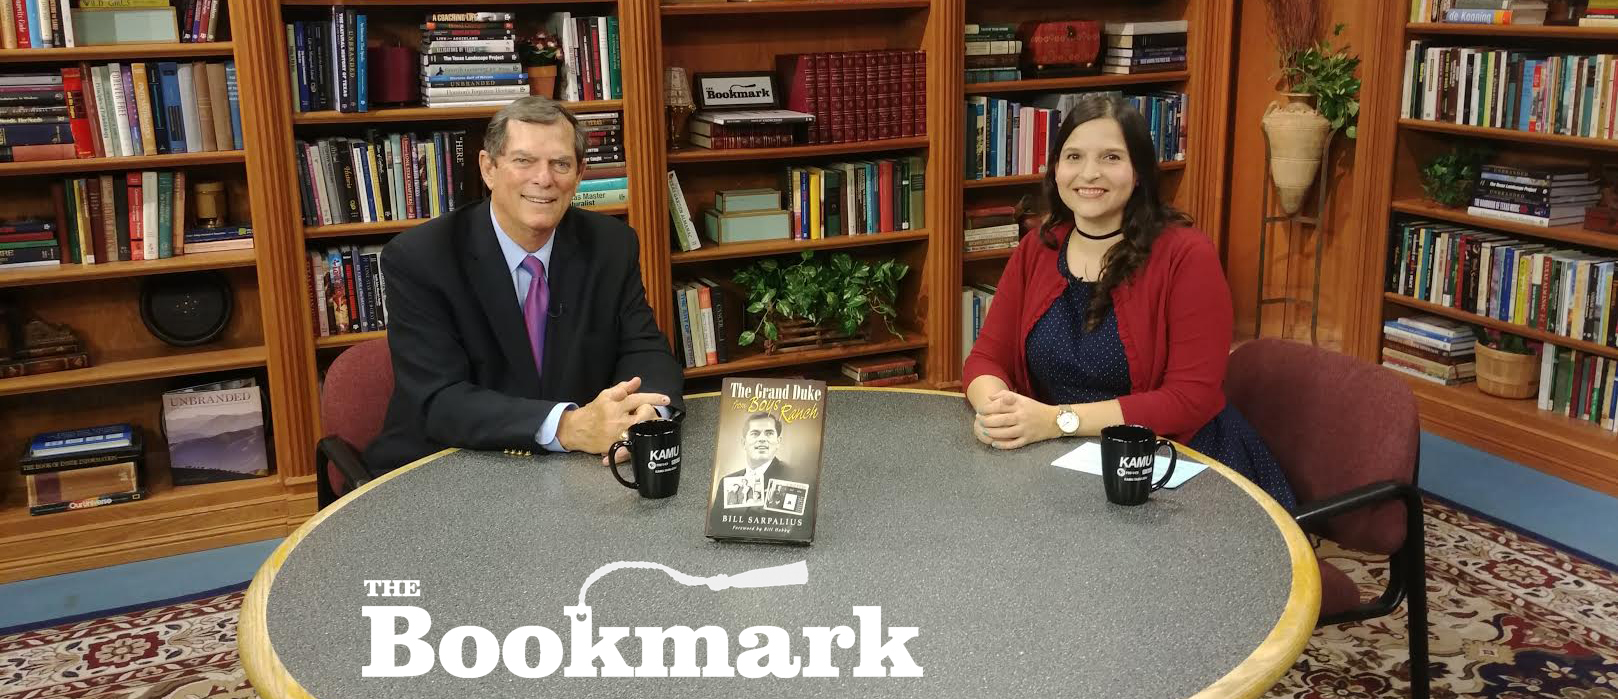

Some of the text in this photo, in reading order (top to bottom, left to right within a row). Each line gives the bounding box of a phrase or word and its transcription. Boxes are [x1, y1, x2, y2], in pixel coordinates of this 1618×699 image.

[437, 13, 464, 21] COACHING
[1449, 9, 1492, 23] de Kooning
[341, 71, 346, 79] OF
[109, 69, 126, 117] FOREVER FREE
[707, 88, 770, 99] Bookmark
[342, 165, 354, 189] Historia
[1493, 168, 1528, 176] UNBRANDED
[405, 179, 414, 204] CHAPTERS
[582, 191, 605, 200] Master
[1489, 189, 1524, 198] UNBRANDED
[672, 192, 684, 213] GARDEN
[679, 213, 694, 238] ALMANAC
[1540, 281, 1548, 312] ALMANAC
[170, 389, 251, 407] UNBRANDED
[730, 382, 822, 401] The Grand Duke
[748, 396, 781, 417] Boys
[779, 403, 818, 423] Ranch
[650, 445, 680, 461] KAMU
[1119, 454, 1153, 468] KAMU
[722, 515, 803, 526] BILL SARPALIUS
